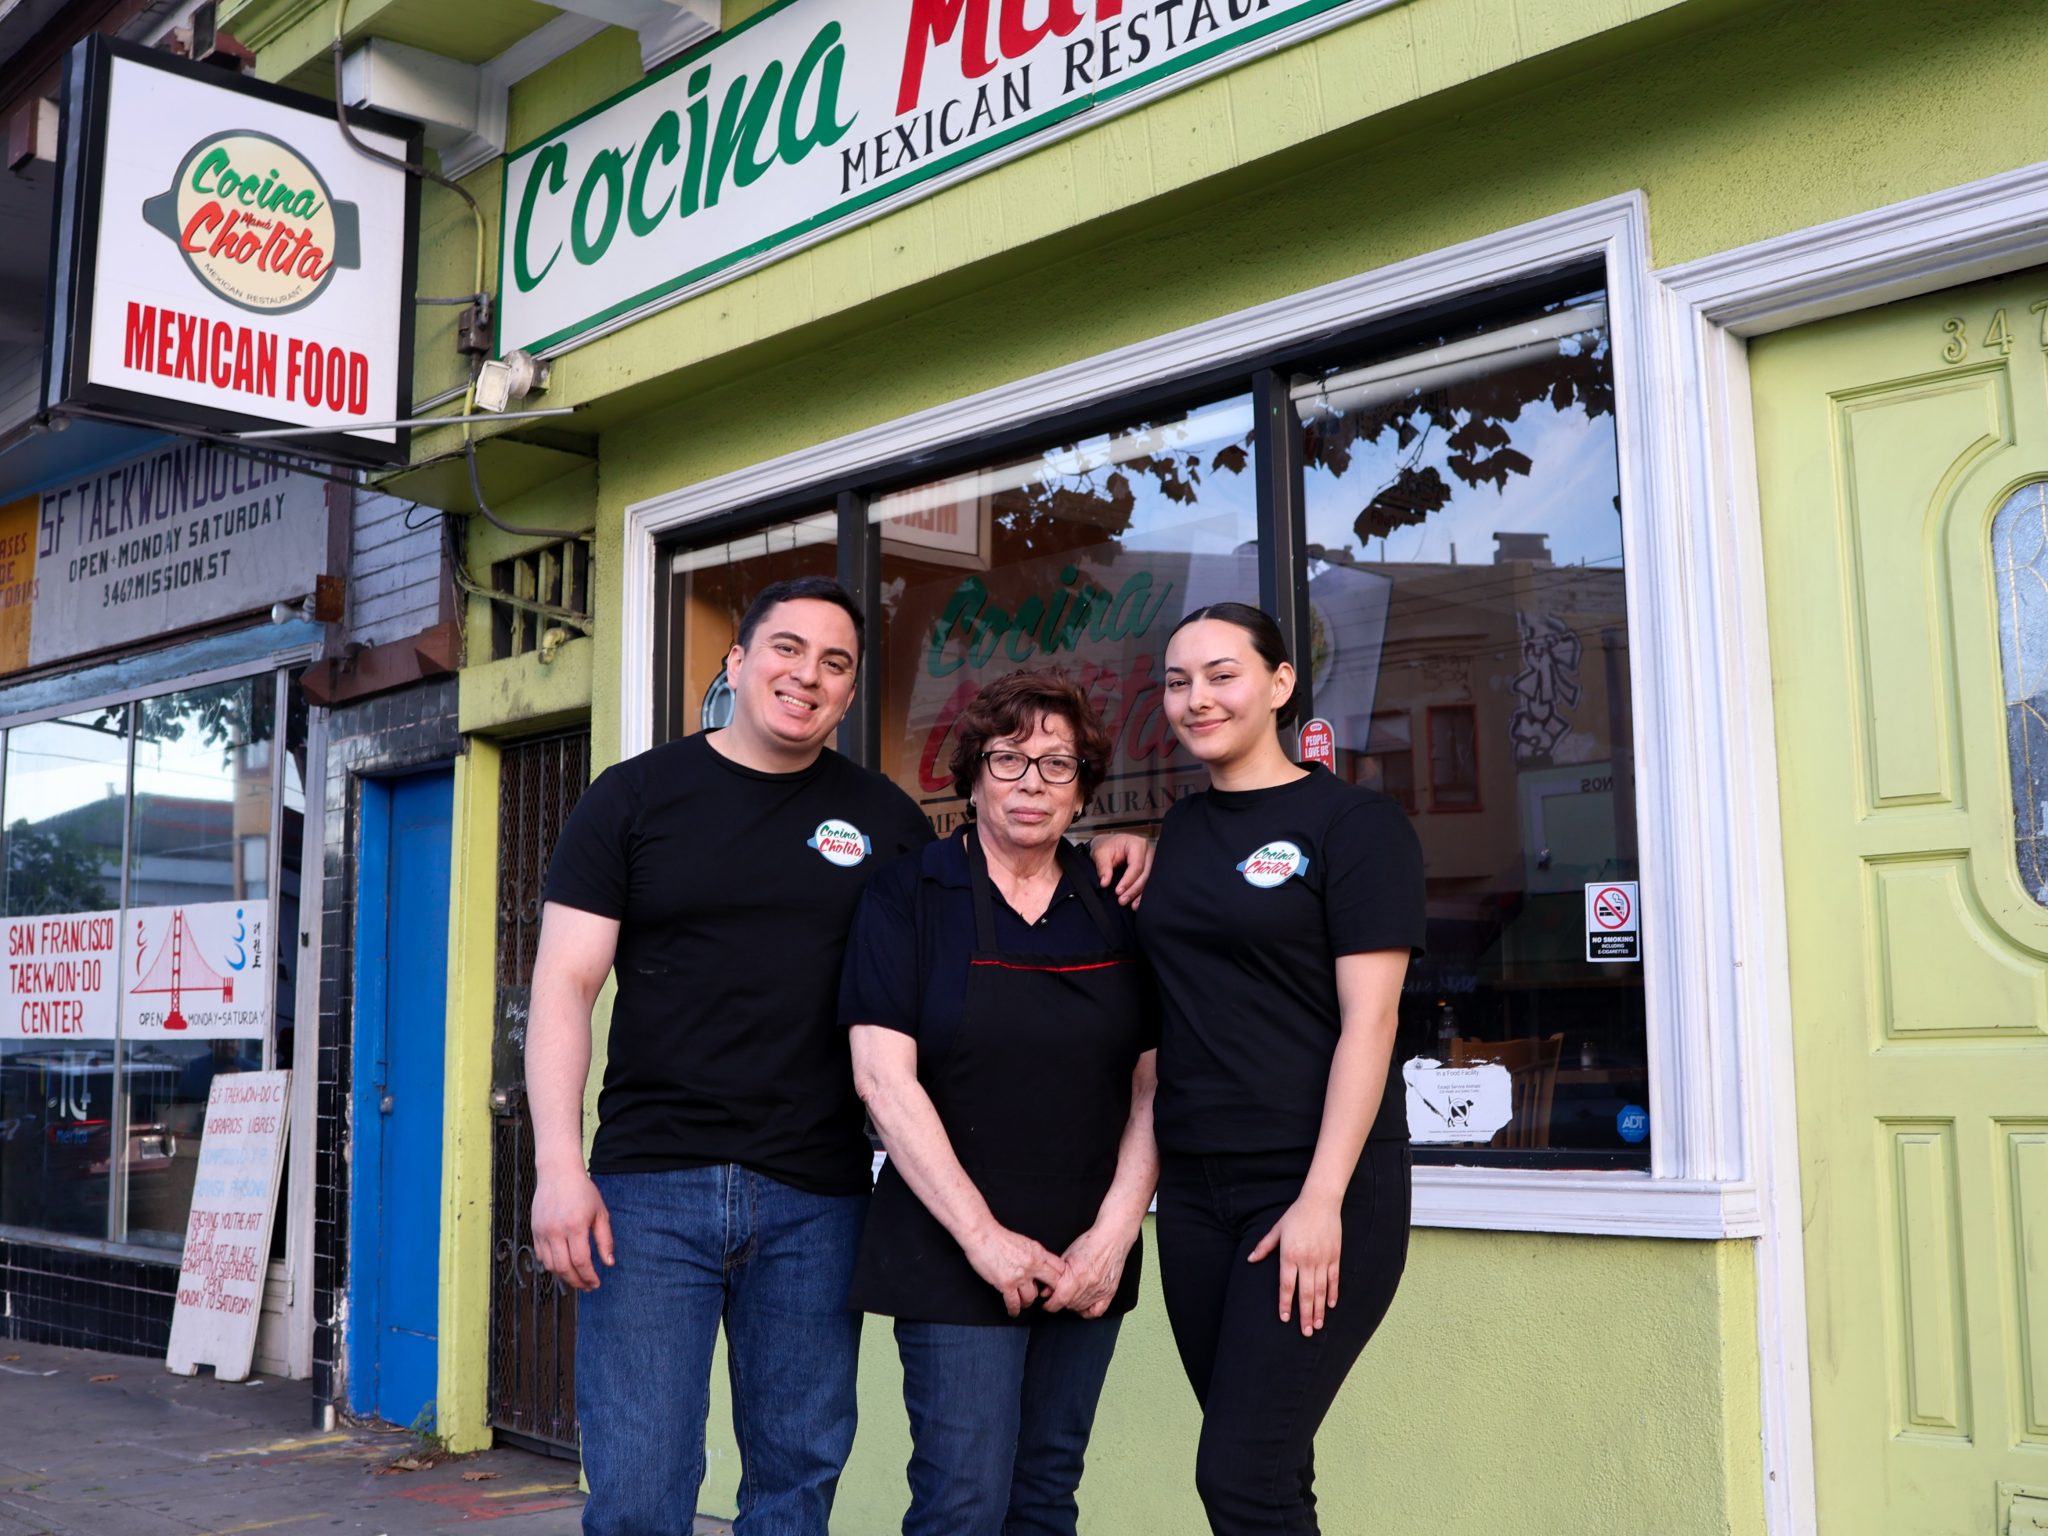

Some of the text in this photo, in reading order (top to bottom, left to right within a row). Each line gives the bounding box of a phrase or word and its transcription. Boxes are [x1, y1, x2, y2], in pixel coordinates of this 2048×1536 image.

[839, 62, 1034, 195] MEXICAN
[513, 20, 859, 294] Cocina
[192, 147, 324, 220] Cocina
[181, 201, 334, 282] Cholita
[204, 263, 303, 305] MEXICAN RESTAURANT
[124, 301, 369, 415] MEXICAN FOOD
[39, 489, 71, 559] SF
[188, 492, 285, 548] SATURDAY
[927, 564, 1173, 678] Cocina
[1305, 733, 1328, 747] PEOPLE
[1305, 744, 1329, 759] LOVE US
[819, 837, 864, 858] Cholita
[820, 825, 859, 841] Cocina
[1244, 860, 1292, 876] Cholita
[1254, 847, 1295, 860] Cocina
[9, 918, 113, 955] SAN FRANCISCO
[1592, 935, 1634, 944] NO SMOKING
[21, 1000, 83, 1034] CENTER
[139, 1012, 163, 1027] OPEN
[1621, 1115, 1646, 1129] ADT
